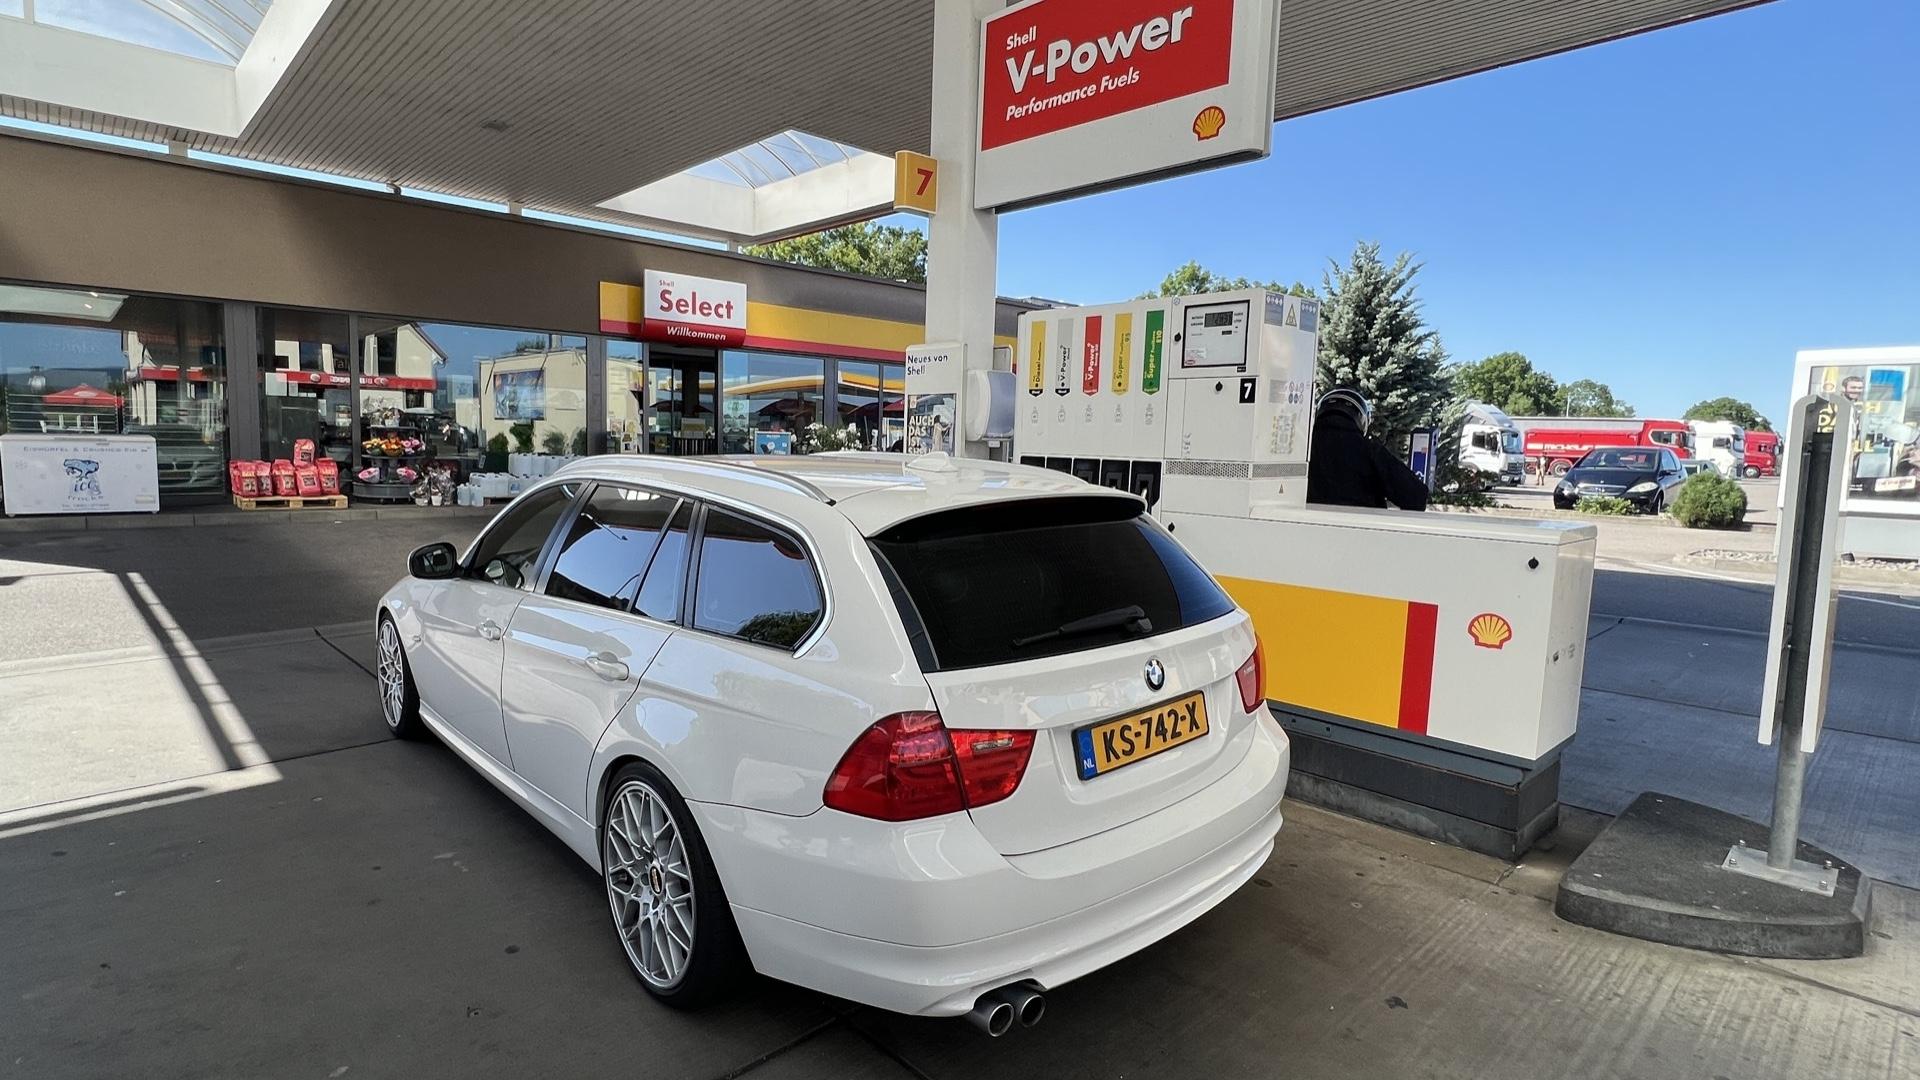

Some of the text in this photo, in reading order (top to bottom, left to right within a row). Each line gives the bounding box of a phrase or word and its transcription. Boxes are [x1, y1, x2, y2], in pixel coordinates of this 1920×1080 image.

[1006, 26, 1037, 51] Shell
[1005, 5, 1194, 95] V-Power
[1005, 66, 1141, 122] Performance Fuels
[916, 167, 934, 196] 7
[658, 279, 675, 287] Shell
[659, 288, 734, 320] Select
[666, 325, 727, 341] Willkommen
[907, 354, 948, 364] Neues von
[1147, 354, 1155, 379] Super
[907, 365, 926, 376] Shell
[1243, 382, 1253, 400] 7
[908, 415, 935, 426] AUCH
[908, 425, 927, 437] DAS
[1102, 701, 1201, 763] KS-742-X
[1083, 758, 1095, 770] NL
